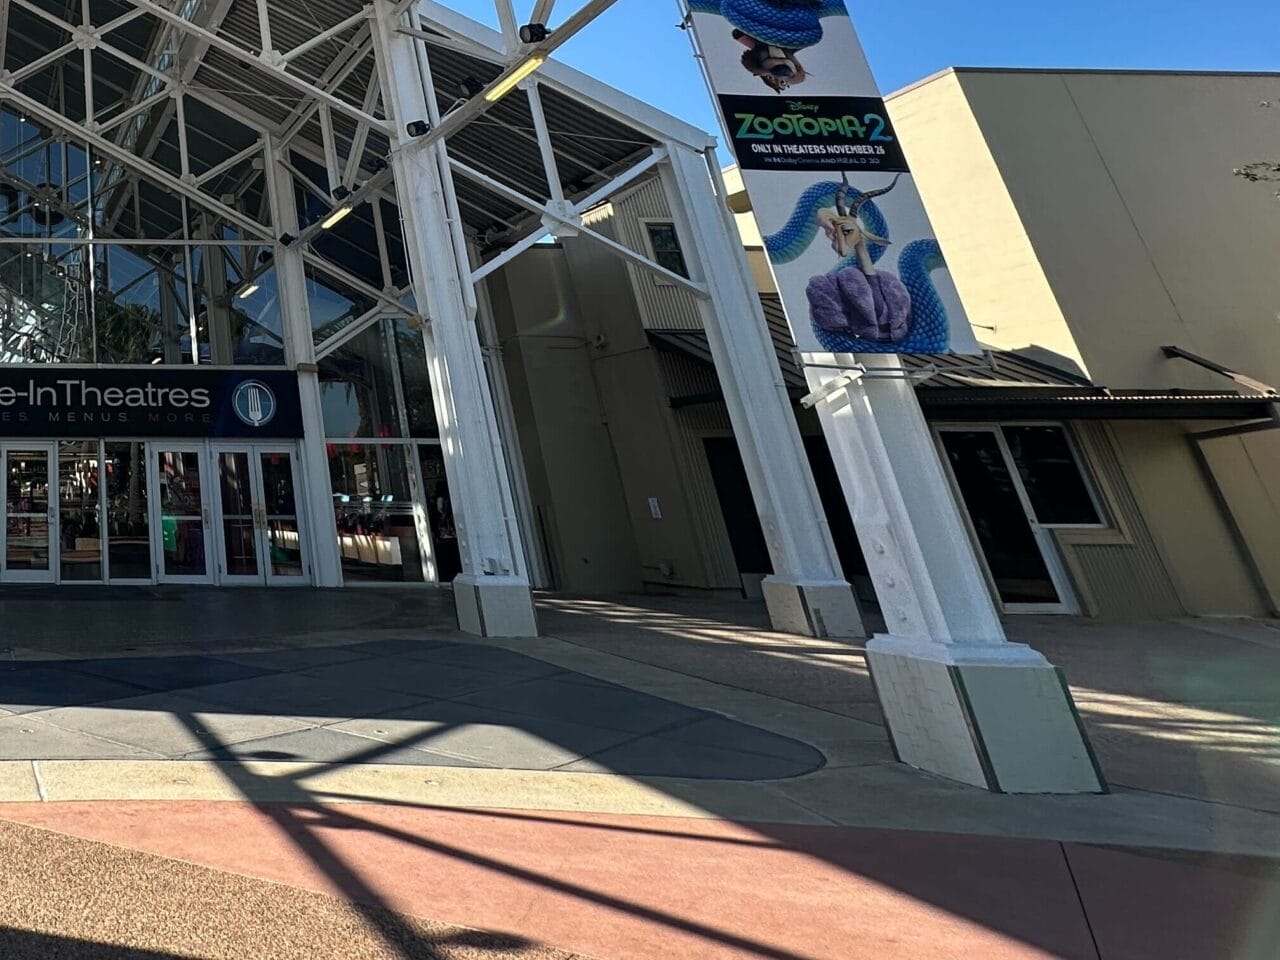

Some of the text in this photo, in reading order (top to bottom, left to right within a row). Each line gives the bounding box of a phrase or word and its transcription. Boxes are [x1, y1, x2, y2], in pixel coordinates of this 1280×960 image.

[734, 113, 893, 141] ZOOTOPIA 2
[751, 143, 885, 155] ONLY IN THEATERS NOVEMBER 26
